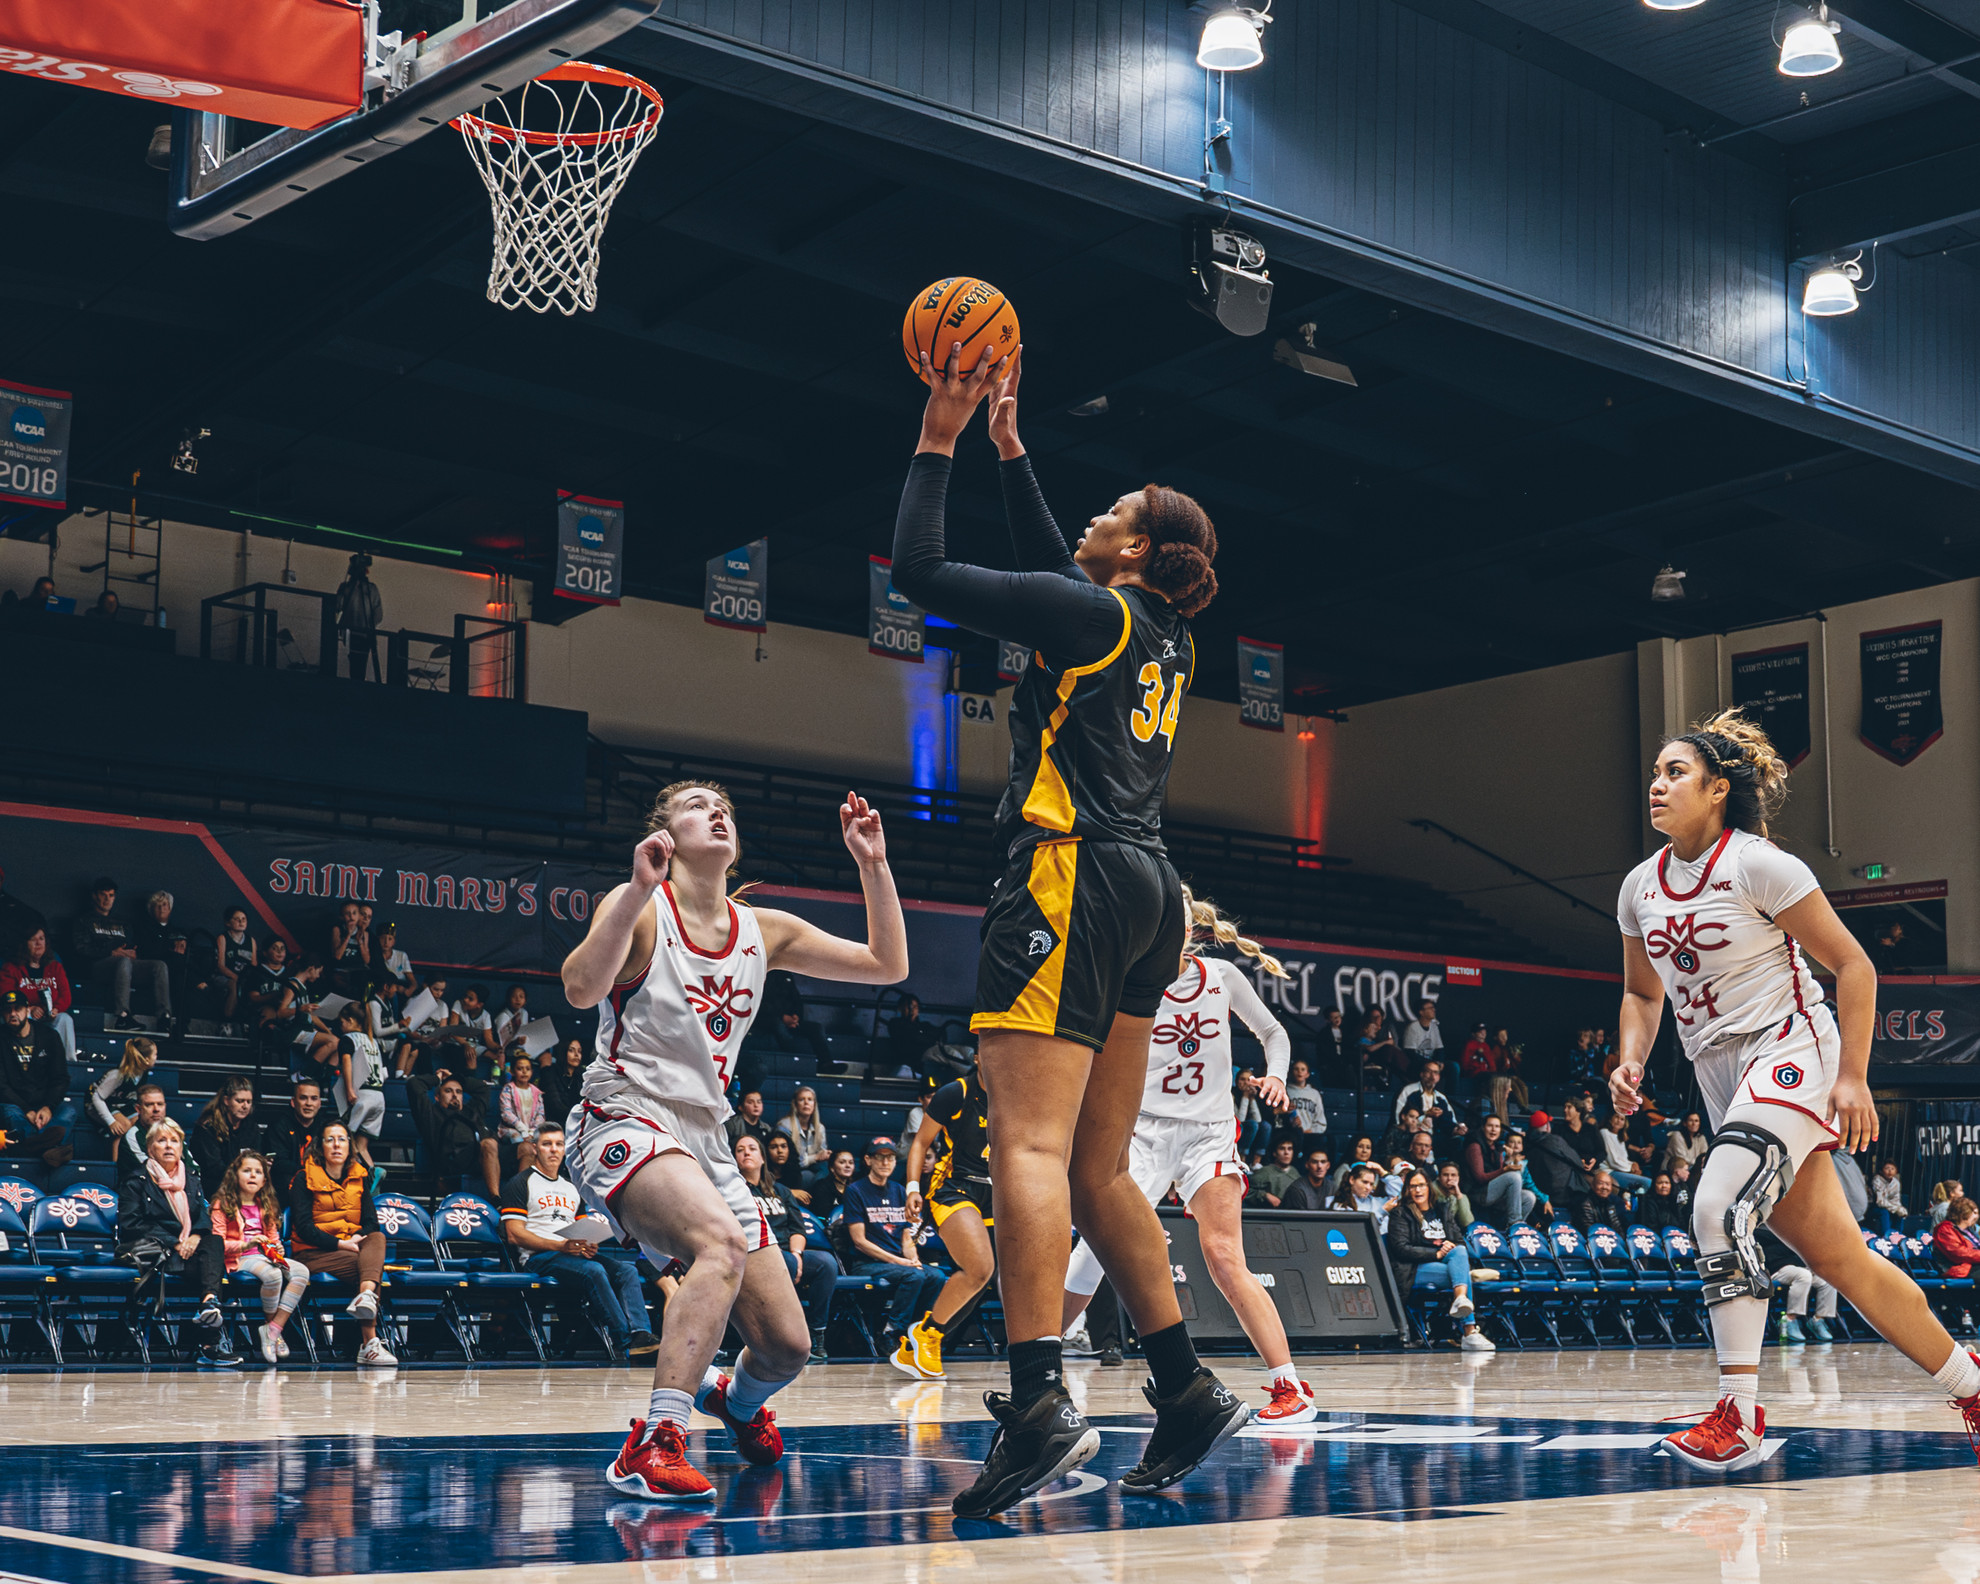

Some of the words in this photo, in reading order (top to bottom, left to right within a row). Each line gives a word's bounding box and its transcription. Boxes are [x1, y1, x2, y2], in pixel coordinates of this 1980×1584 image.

[922, 278, 956, 311] CAA
[15, 422, 45, 436] NCAA
[0, 461, 57, 495] 2018
[565, 563, 612, 593] 2012
[710, 591, 762, 621] 2009
[874, 622, 920, 652] 2008
[962, 696, 995, 722] GA
[1130, 661, 1186, 753] 34
[1241, 696, 1281, 722] 2003
[1710, 880, 1733, 892] WCC
[1867, 864, 1882, 879] EXIT
[269, 858, 383, 902] SAINT
[396, 869, 538, 917] MARY'S
[1447, 965, 1475, 976] SECTION
[1333, 965, 1443, 1022] FORCE
[1676, 981, 1723, 1026] 24
[1162, 1061, 1205, 1095] 23
[47, 1198, 91, 1218] SMC
[537, 1194, 576, 1213] SEALS
[1326, 1266, 1366, 1284] GUEST
